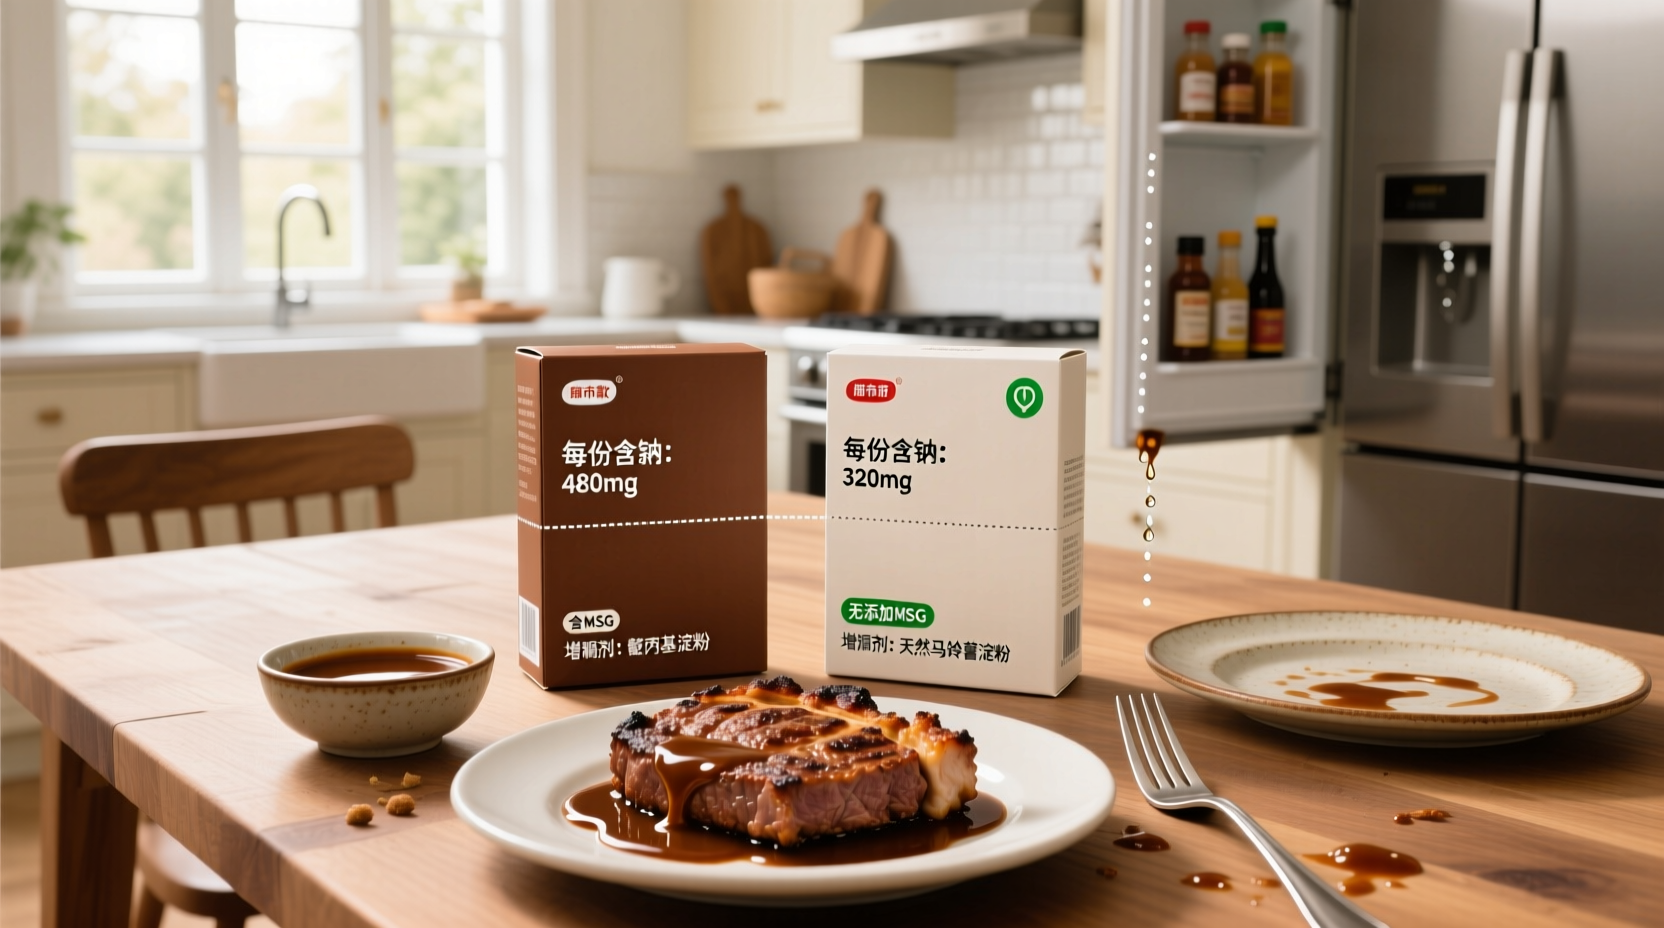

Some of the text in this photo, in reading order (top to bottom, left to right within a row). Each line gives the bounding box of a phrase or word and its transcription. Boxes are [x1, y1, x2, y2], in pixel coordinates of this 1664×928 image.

[561, 472, 638, 498] 480mg
[842, 467, 912, 495] 320mg
[848, 602, 927, 623] 无添加MSG
